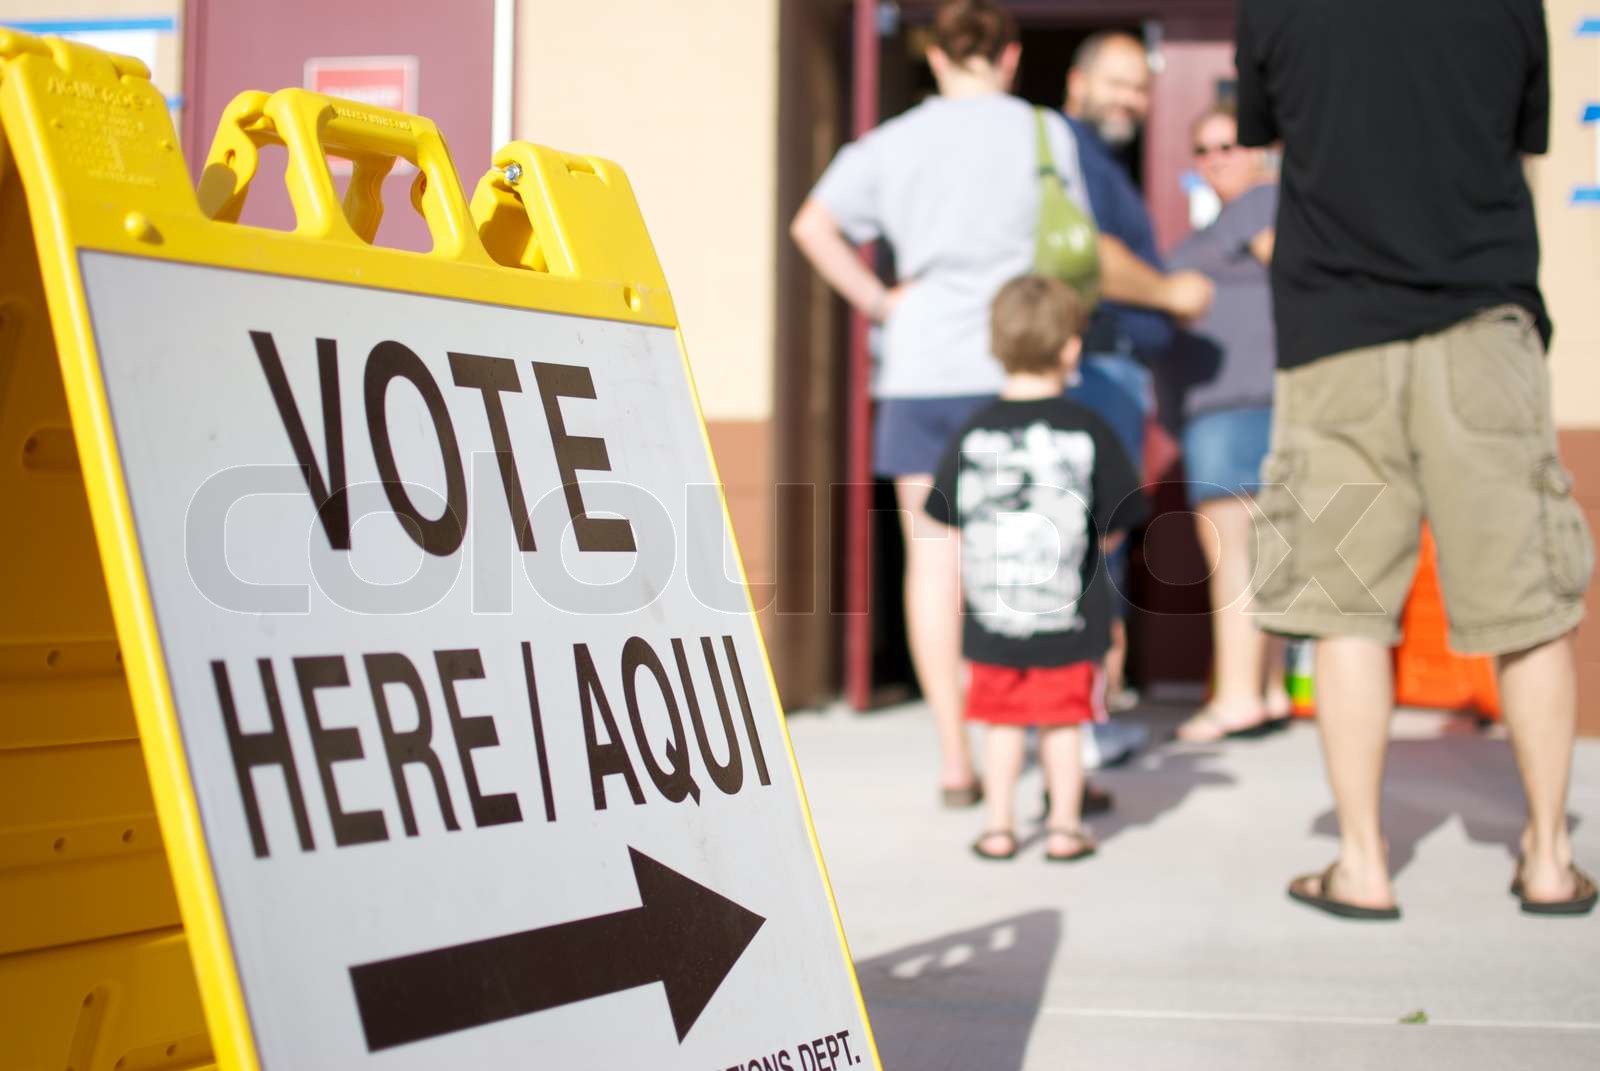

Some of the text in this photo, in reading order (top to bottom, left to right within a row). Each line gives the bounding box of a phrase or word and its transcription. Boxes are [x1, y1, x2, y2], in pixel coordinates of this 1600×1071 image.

[248, 330, 637, 556] VOTE
[573, 635, 772, 810] AQUI
[797, 1030, 861, 1071] DEPT.
